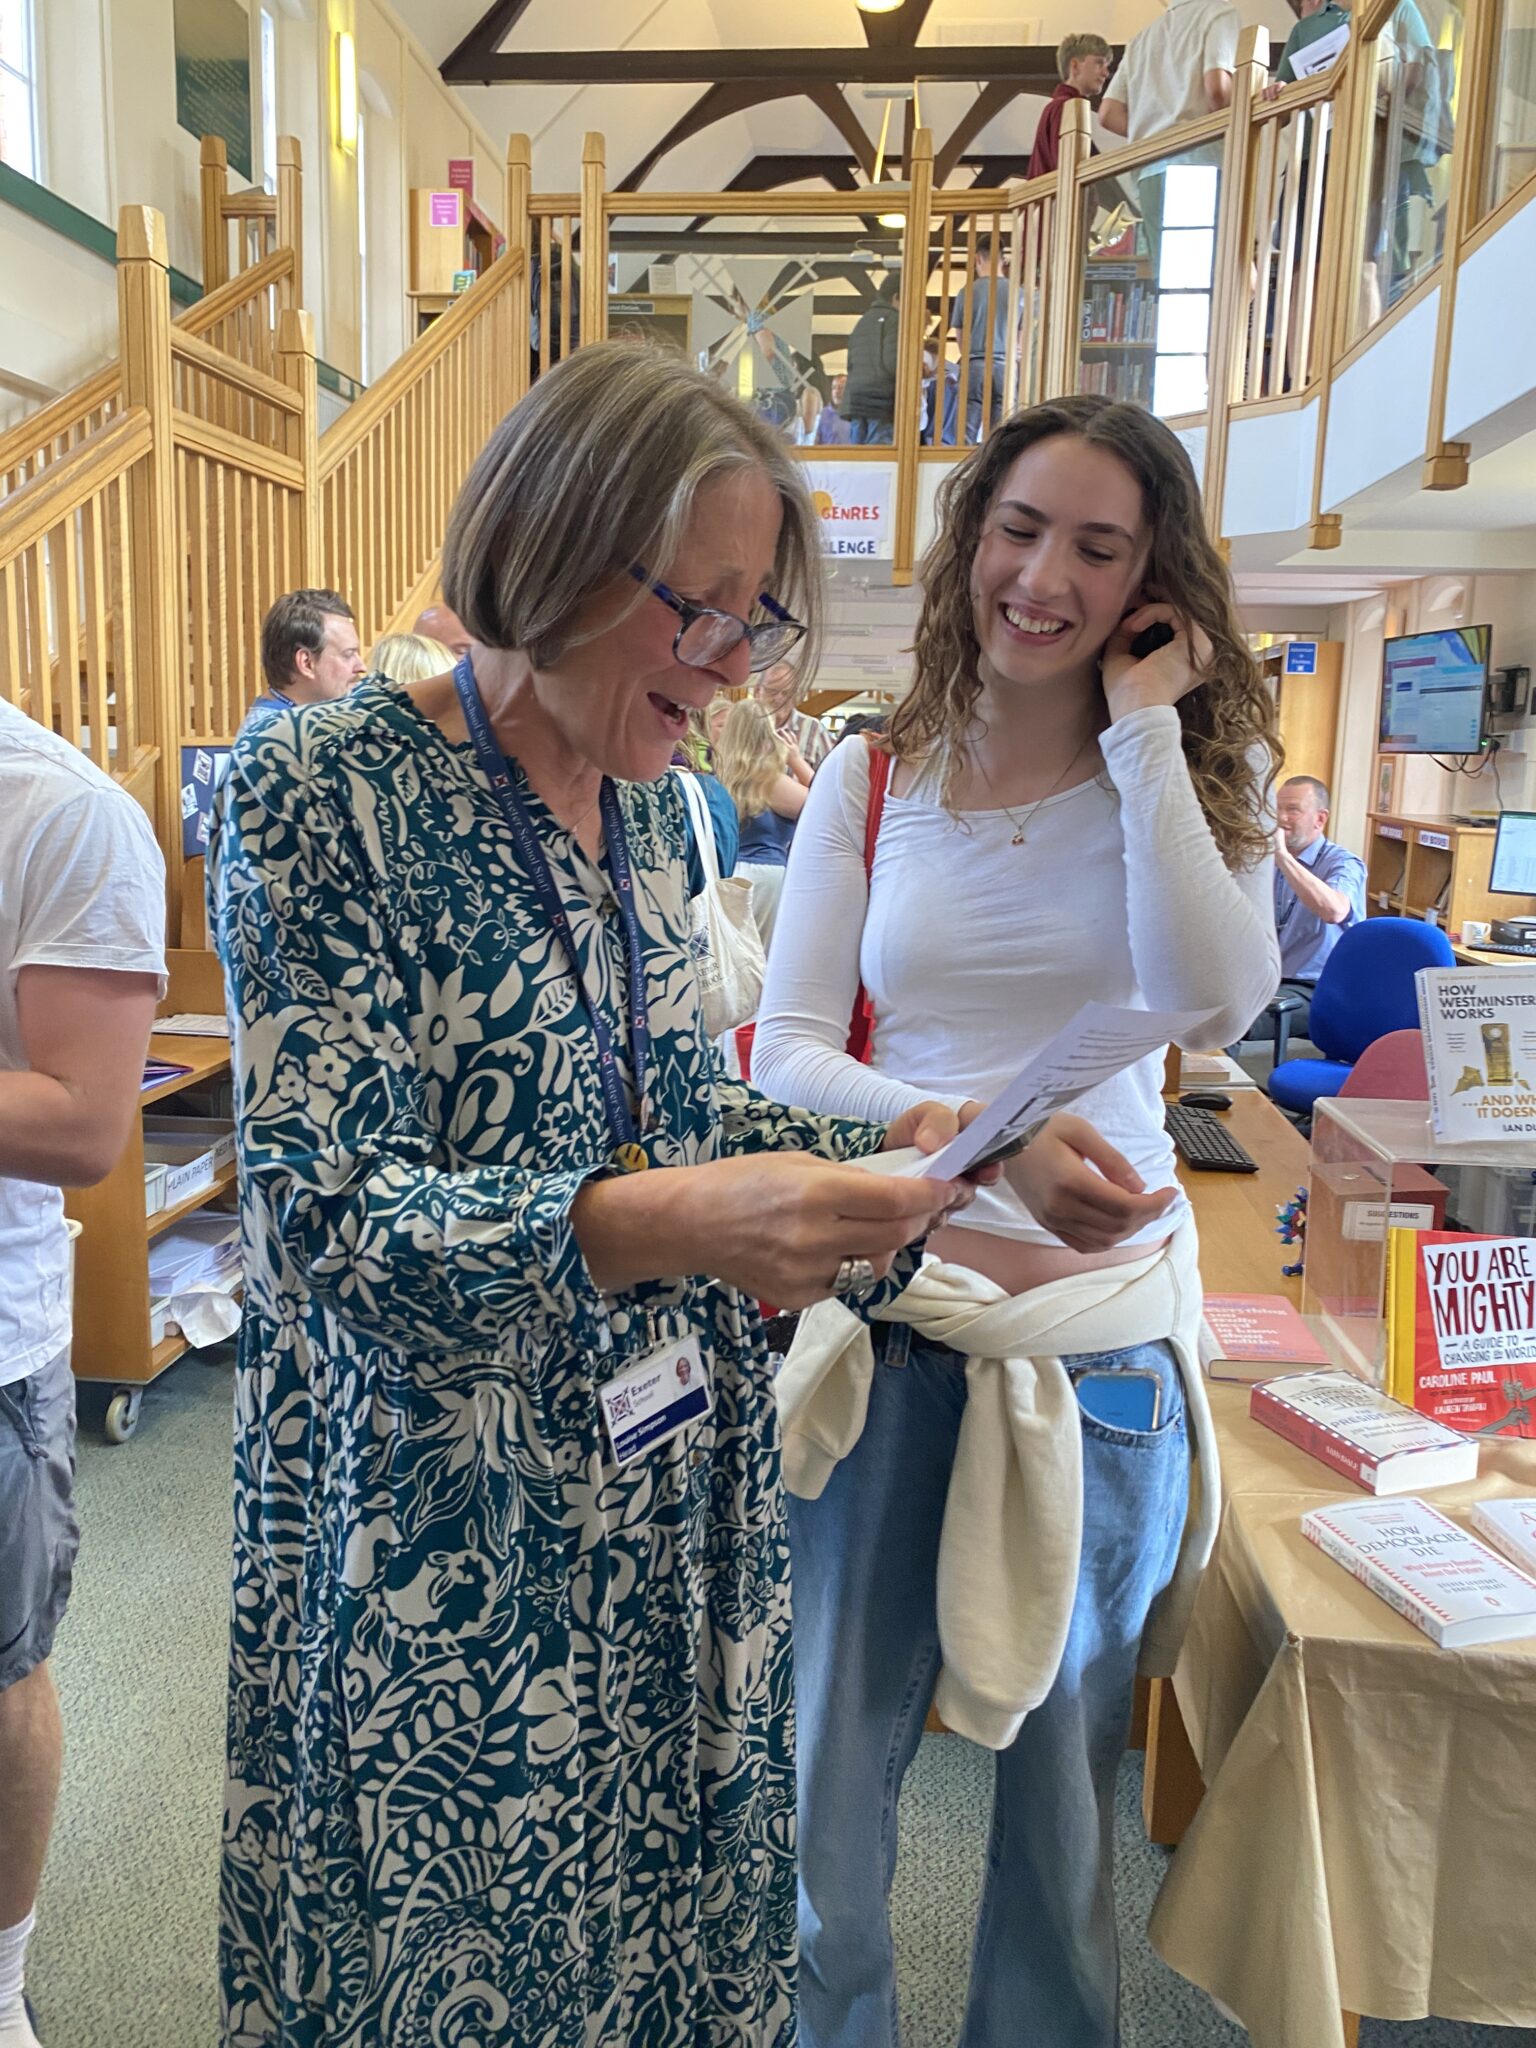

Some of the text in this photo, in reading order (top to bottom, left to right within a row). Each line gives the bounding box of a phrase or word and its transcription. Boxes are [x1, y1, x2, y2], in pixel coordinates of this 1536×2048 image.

[820, 506, 880, 520] GENRES
[827, 541, 876, 554] LENGE
[457, 666, 495, 756] Exeter School Staff
[605, 805, 620, 840] School
[501, 791, 552, 894] Exeter School Staff
[615, 842, 628, 874] Exeter
[632, 940, 643, 978] School
[697, 962, 720, 977] XETER
[635, 979, 645, 1011] Exeter
[1438, 985, 1476, 996] HOW
[1440, 995, 1536, 1008] WESTMINSTER
[1441, 1008, 1495, 1019] WORKS
[605, 1068, 627, 1143] Exeter School
[1514, 1095, 1536, 1105] WH
[1477, 1107, 1536, 1118] IT DOESN
[1503, 1124, 1522, 1132] IAN
[168, 1157, 213, 1192] PLAIN PAPER
[1428, 1245, 1533, 1286] YOU ARE
[1434, 1280, 1535, 1338] MIGHTY
[1212, 1317, 1258, 1325] really
[1461, 1335, 1519, 1350] A GUIDE TO
[1444, 1350, 1491, 1365] CHANGING
[1504, 1346, 1536, 1359] WORLD
[630, 1374, 662, 1397] Exeter
[1419, 1370, 1498, 1389] CAROLINE PAUL
[1331, 1410, 1414, 1428] PRESIDENTS
[1376, 1525, 1421, 1538] HOW
[1356, 1532, 1469, 1554] DEMOCRACIES
[1410, 1545, 1444, 1557] DIE
